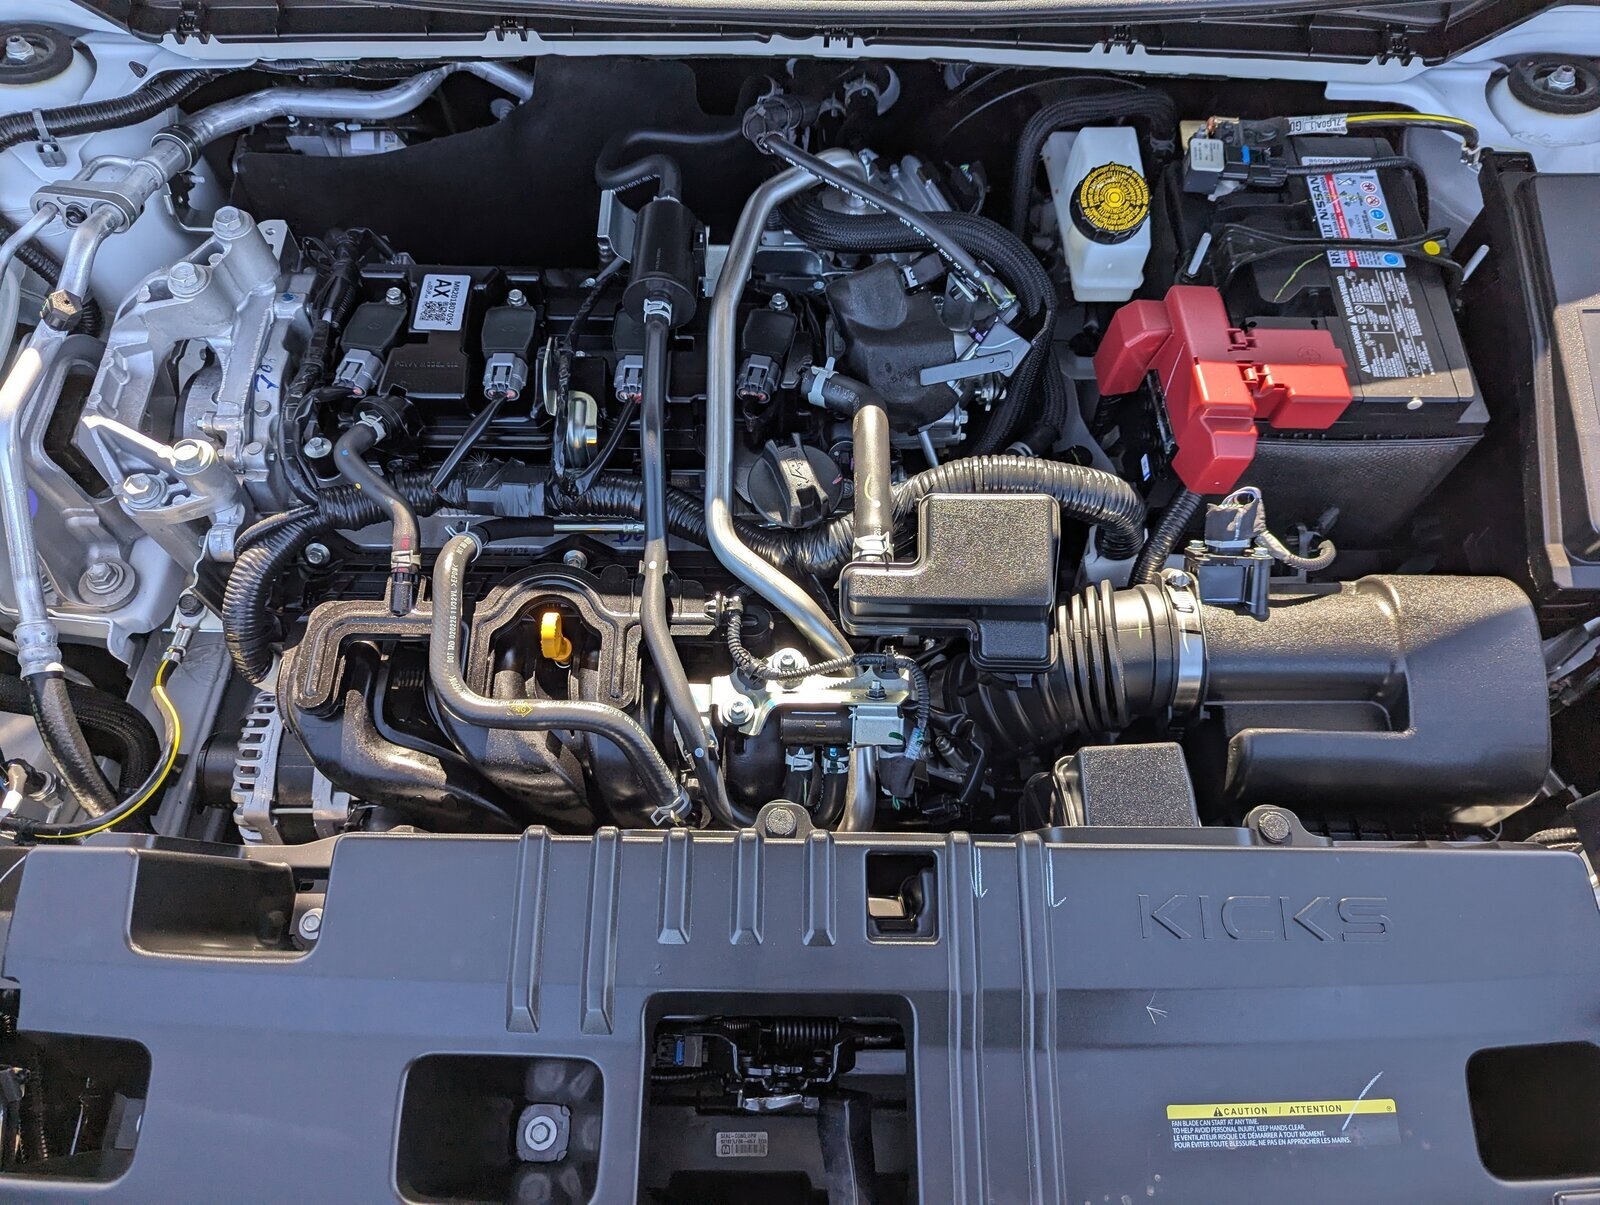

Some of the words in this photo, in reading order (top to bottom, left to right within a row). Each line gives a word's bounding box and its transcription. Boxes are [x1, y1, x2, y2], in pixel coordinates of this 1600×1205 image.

[1310, 176, 1329, 220] NISSAN
[432, 278, 452, 298] AX
[446, 280, 461, 326] MR20180705K
[1350, 324, 1368, 366] DANGER/POISON
[1138, 894, 1392, 942] KICKS
[1224, 1107, 1268, 1116] CAUTION
[1290, 1105, 1342, 1114] ATTENTION
